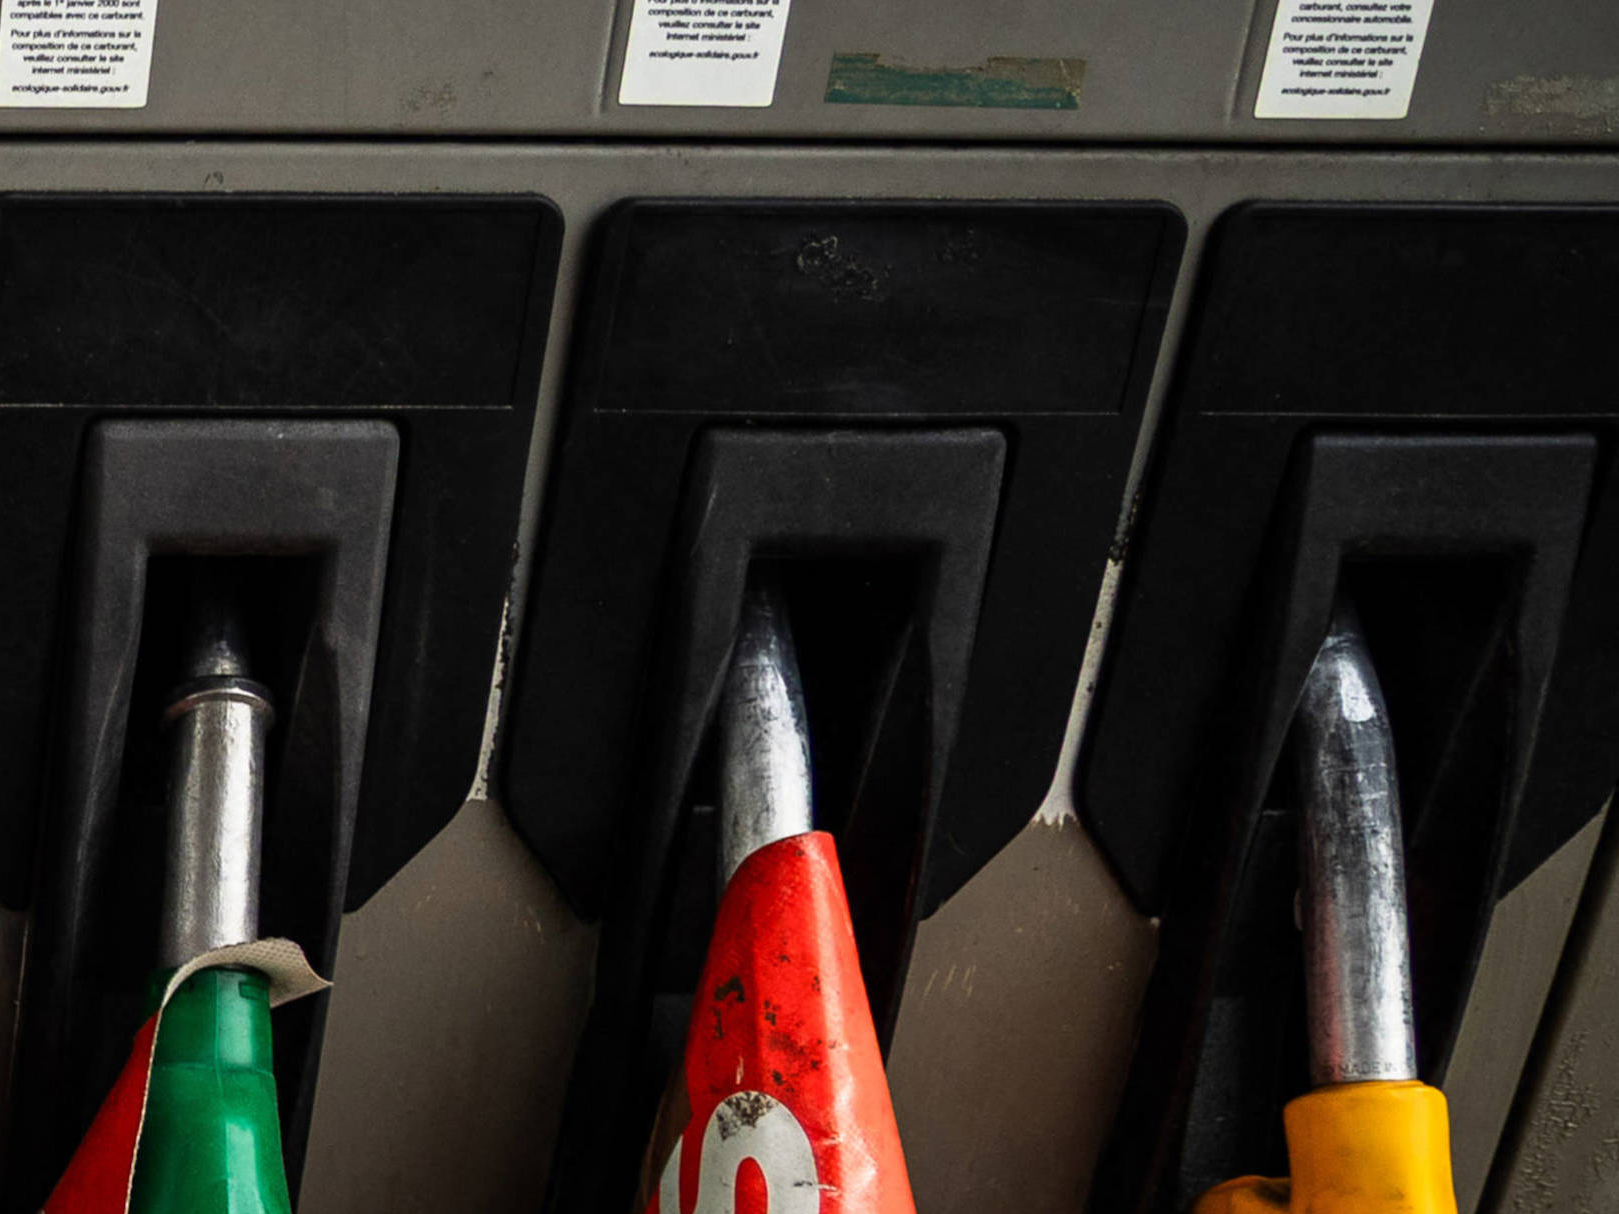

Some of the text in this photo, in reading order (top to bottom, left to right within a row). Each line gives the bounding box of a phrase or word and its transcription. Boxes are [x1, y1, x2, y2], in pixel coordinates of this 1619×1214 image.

[1390, 3, 1412, 11] votre
[10, 11, 63, 21] compatibles
[65, 12, 86, 20] avec
[88, 12, 99, 20] ce
[648, 9, 701, 19] composition
[704, 9, 715, 17] de
[1291, 15, 1361, 23] concessionnaire
[659, 21, 760, 30] veuillez consulter le site
[11, 29, 31, 38] Pour
[33, 30, 51, 39] plus
[133, 30, 141, 38] la
[1283, 33, 1303, 42] Pour
[1305, 33, 1324, 43] plus
[1406, 34, 1414, 42] la
[11, 42, 65, 52] composition
[67, 42, 78, 50] de
[1282, 45, 1335, 55] composition
[1338, 46, 1349, 54] de
[23, 54, 124, 62] veuillez consulter le site
[1292, 57, 1393, 66] veuillez consulter le site
[66, 66, 110, 75] ministériel
